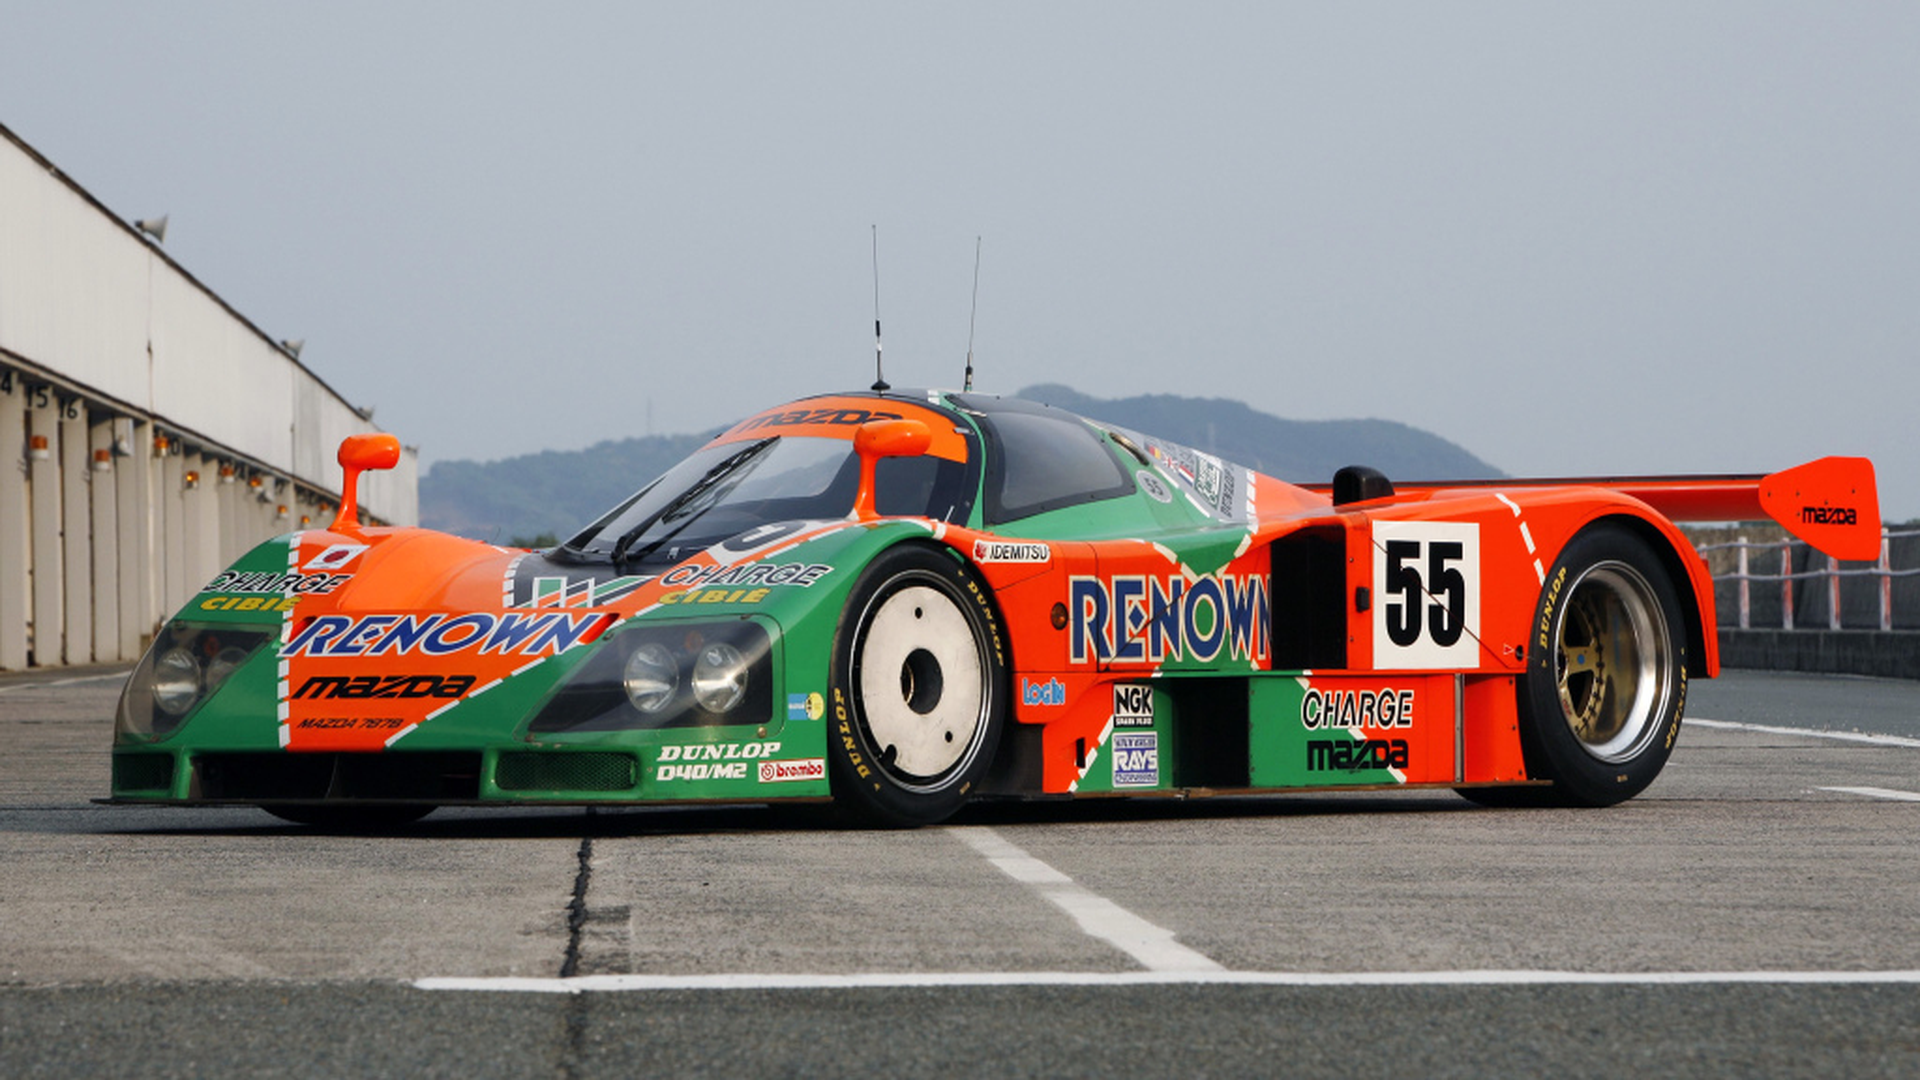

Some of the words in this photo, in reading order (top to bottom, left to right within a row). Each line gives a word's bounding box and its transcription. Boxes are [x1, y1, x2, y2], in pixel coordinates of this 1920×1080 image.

[1802, 507, 1857, 525] mazda
[989, 544, 1048, 560] IDEMITSU
[201, 570, 355, 593] CHARGE
[660, 564, 834, 587] CHARGE
[1386, 540, 1465, 647] 55
[1540, 566, 1567, 650] DUNLOP
[967, 581, 1004, 667] DUNLOP
[1069, 574, 1272, 664] RENOWN
[277, 613, 605, 657] RENOWN
[291, 675, 477, 699] mazda
[1115, 687, 1153, 714] NGK
[1301, 687, 1414, 731] CHARGE
[833, 687, 871, 779] DUNLOP
[656, 742, 781, 761] DUNLOP
[1114, 750, 1158, 772] RAYS
[1307, 740, 1409, 771] mazda
